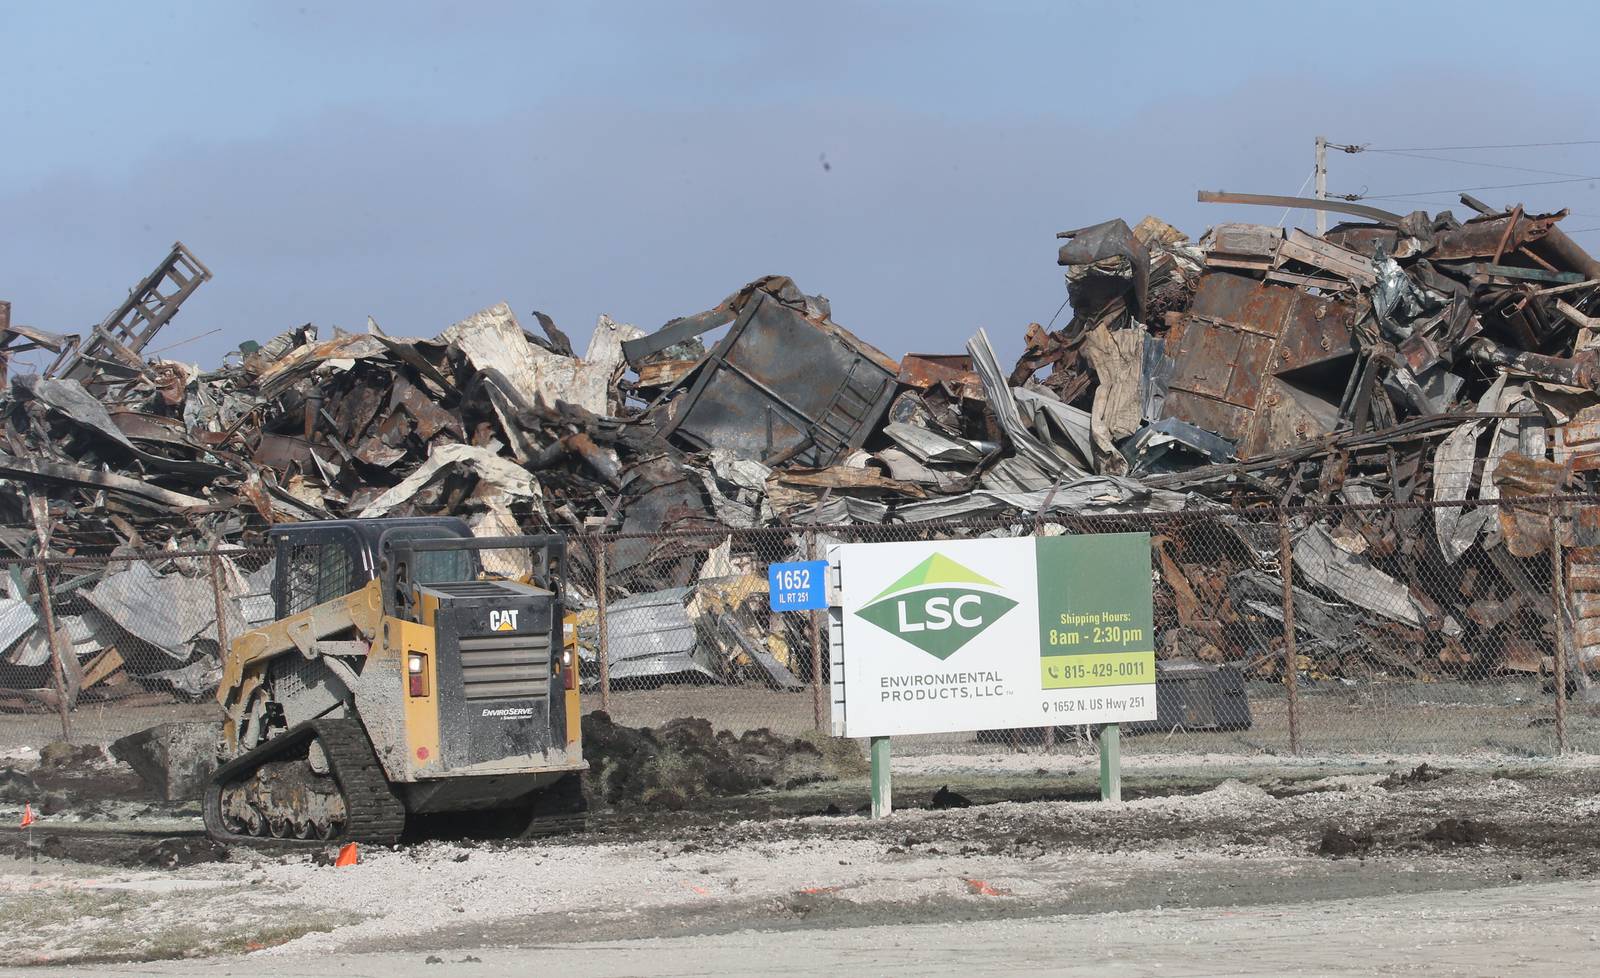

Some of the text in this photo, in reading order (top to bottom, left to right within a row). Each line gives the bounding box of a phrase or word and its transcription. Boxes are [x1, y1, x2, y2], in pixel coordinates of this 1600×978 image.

[776, 569, 811, 590] 1652
[779, 592, 809, 604] IL RT 251
[489, 609, 519, 631] CAT
[897, 594, 983, 633] LSC
[1060, 611, 1131, 627] Shipping Hours:
[880, 671, 1003, 688] ENVIRONMENTAL
[1064, 661, 1145, 680] 815-429-0011
[1053, 696, 1145, 713] 1652 N. US Hwy 251
